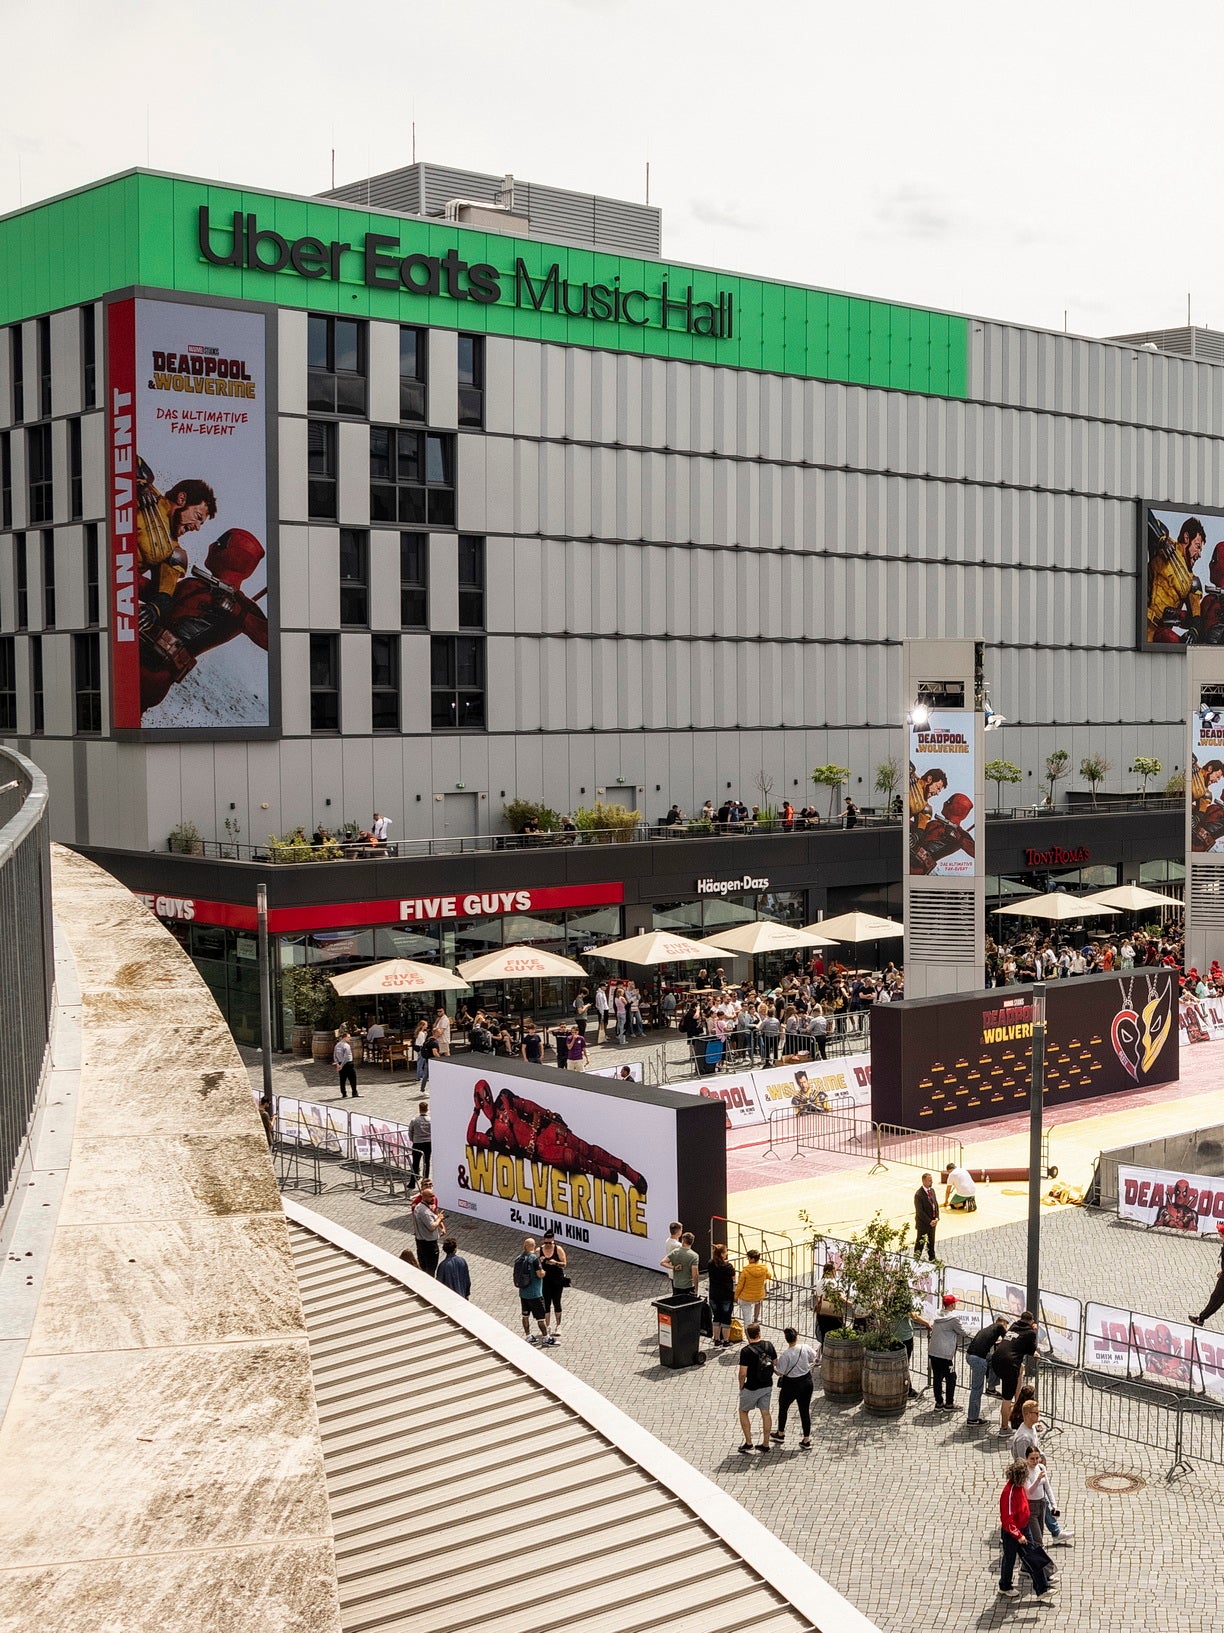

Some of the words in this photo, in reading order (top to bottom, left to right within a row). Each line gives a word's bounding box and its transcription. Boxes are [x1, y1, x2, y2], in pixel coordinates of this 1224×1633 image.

[198, 205, 352, 281] Uber
[364, 232, 502, 303] Eats
[514, 257, 650, 327] Music
[661, 272, 733, 339] Hall
[152, 351, 251, 380] DEADPOOL
[157, 408, 178, 419] DAS
[182, 410, 248, 423] ULTIMATIVE
[171, 423, 235, 435] FAN-EVENT
[113, 388, 135, 642] FAN-EVENT
[918, 734, 967, 744] DEADPOOL
[156, 896, 195, 920] GUYS
[400, 897, 457, 921] FIVE
[463, 891, 531, 915] GUYS
[381, 978, 425, 986] GUYS
[384, 973, 419, 981] FIVE
[510, 1208, 525, 1225] 24.
[528, 1213, 547, 1231] JULI
[550, 1219, 562, 1236] IM
[566, 1224, 589, 1243] KINO
